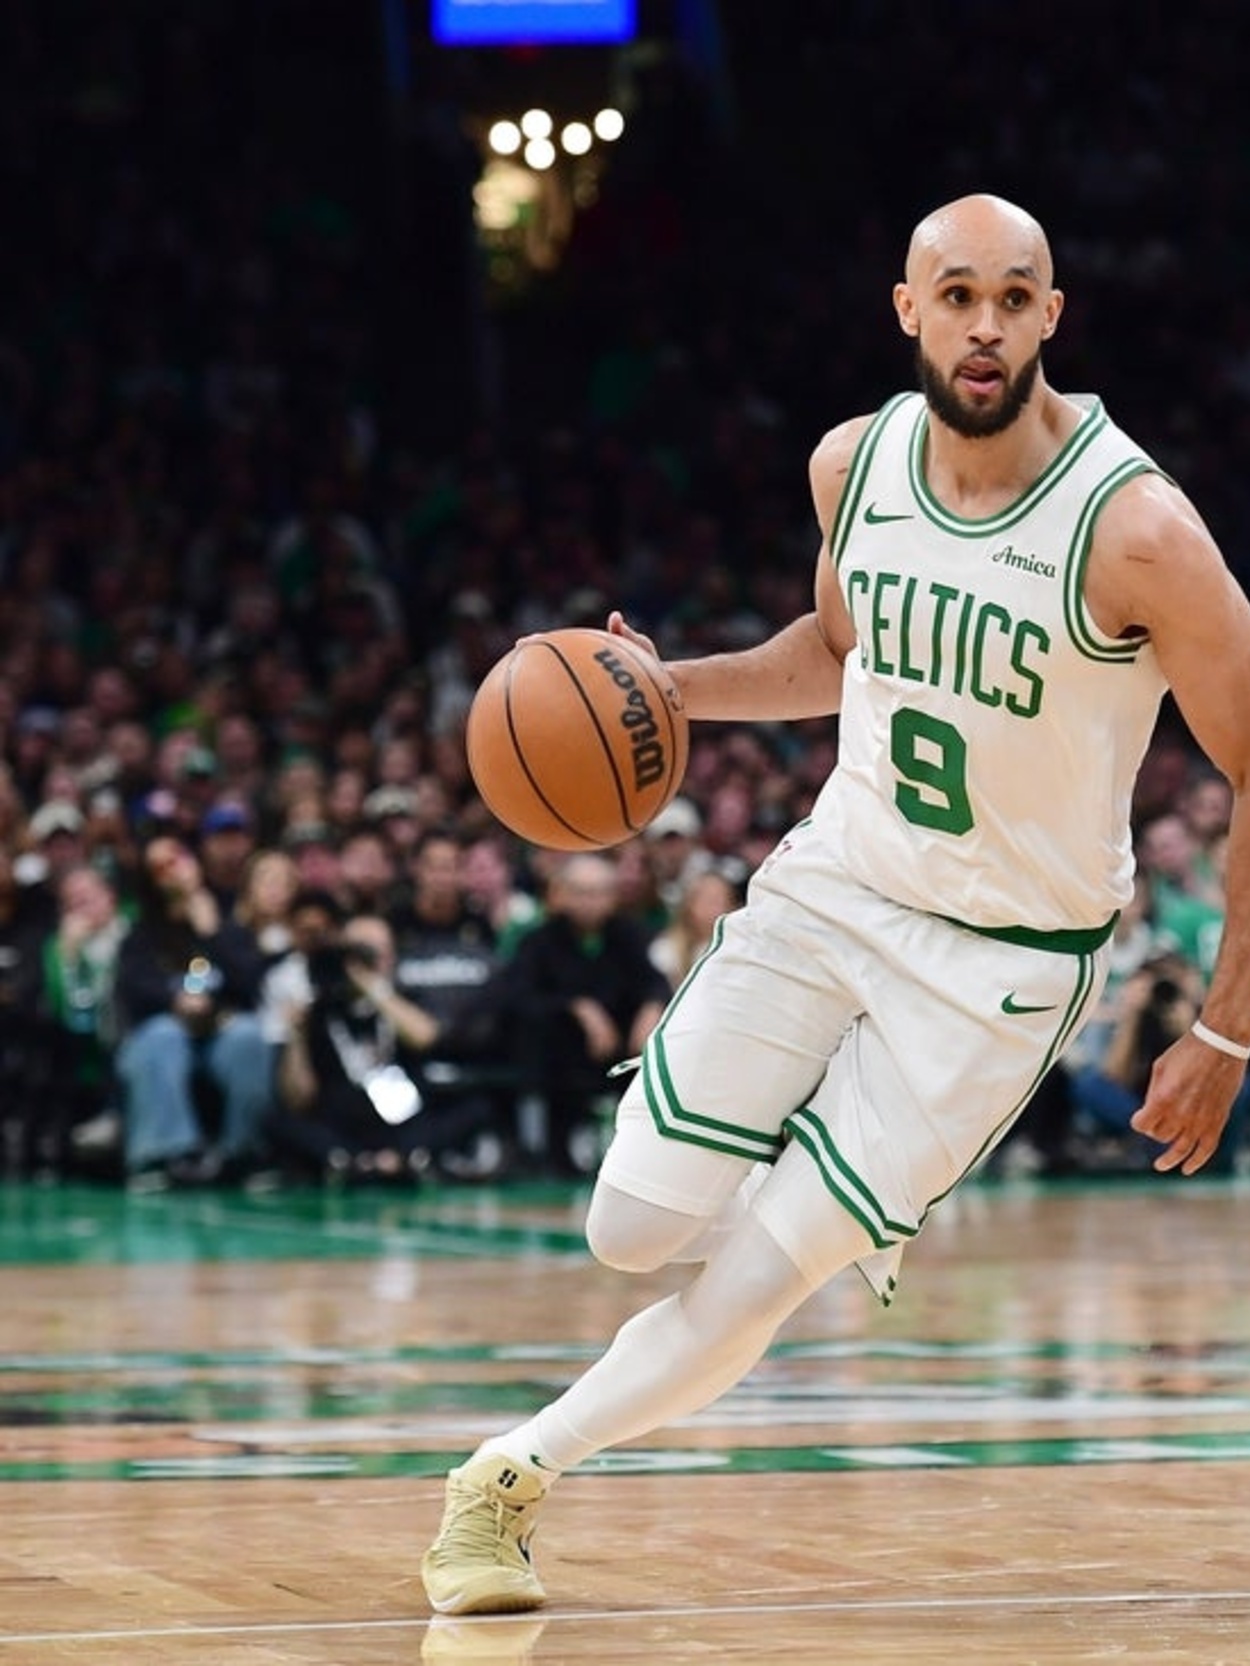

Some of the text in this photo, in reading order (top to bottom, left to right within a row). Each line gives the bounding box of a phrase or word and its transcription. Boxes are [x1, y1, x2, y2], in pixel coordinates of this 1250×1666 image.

[992, 545, 1056, 578] Amica
[848, 570, 1050, 719] CELTICS
[593, 648, 665, 793] Wilson
[891, 706, 975, 836] 9
